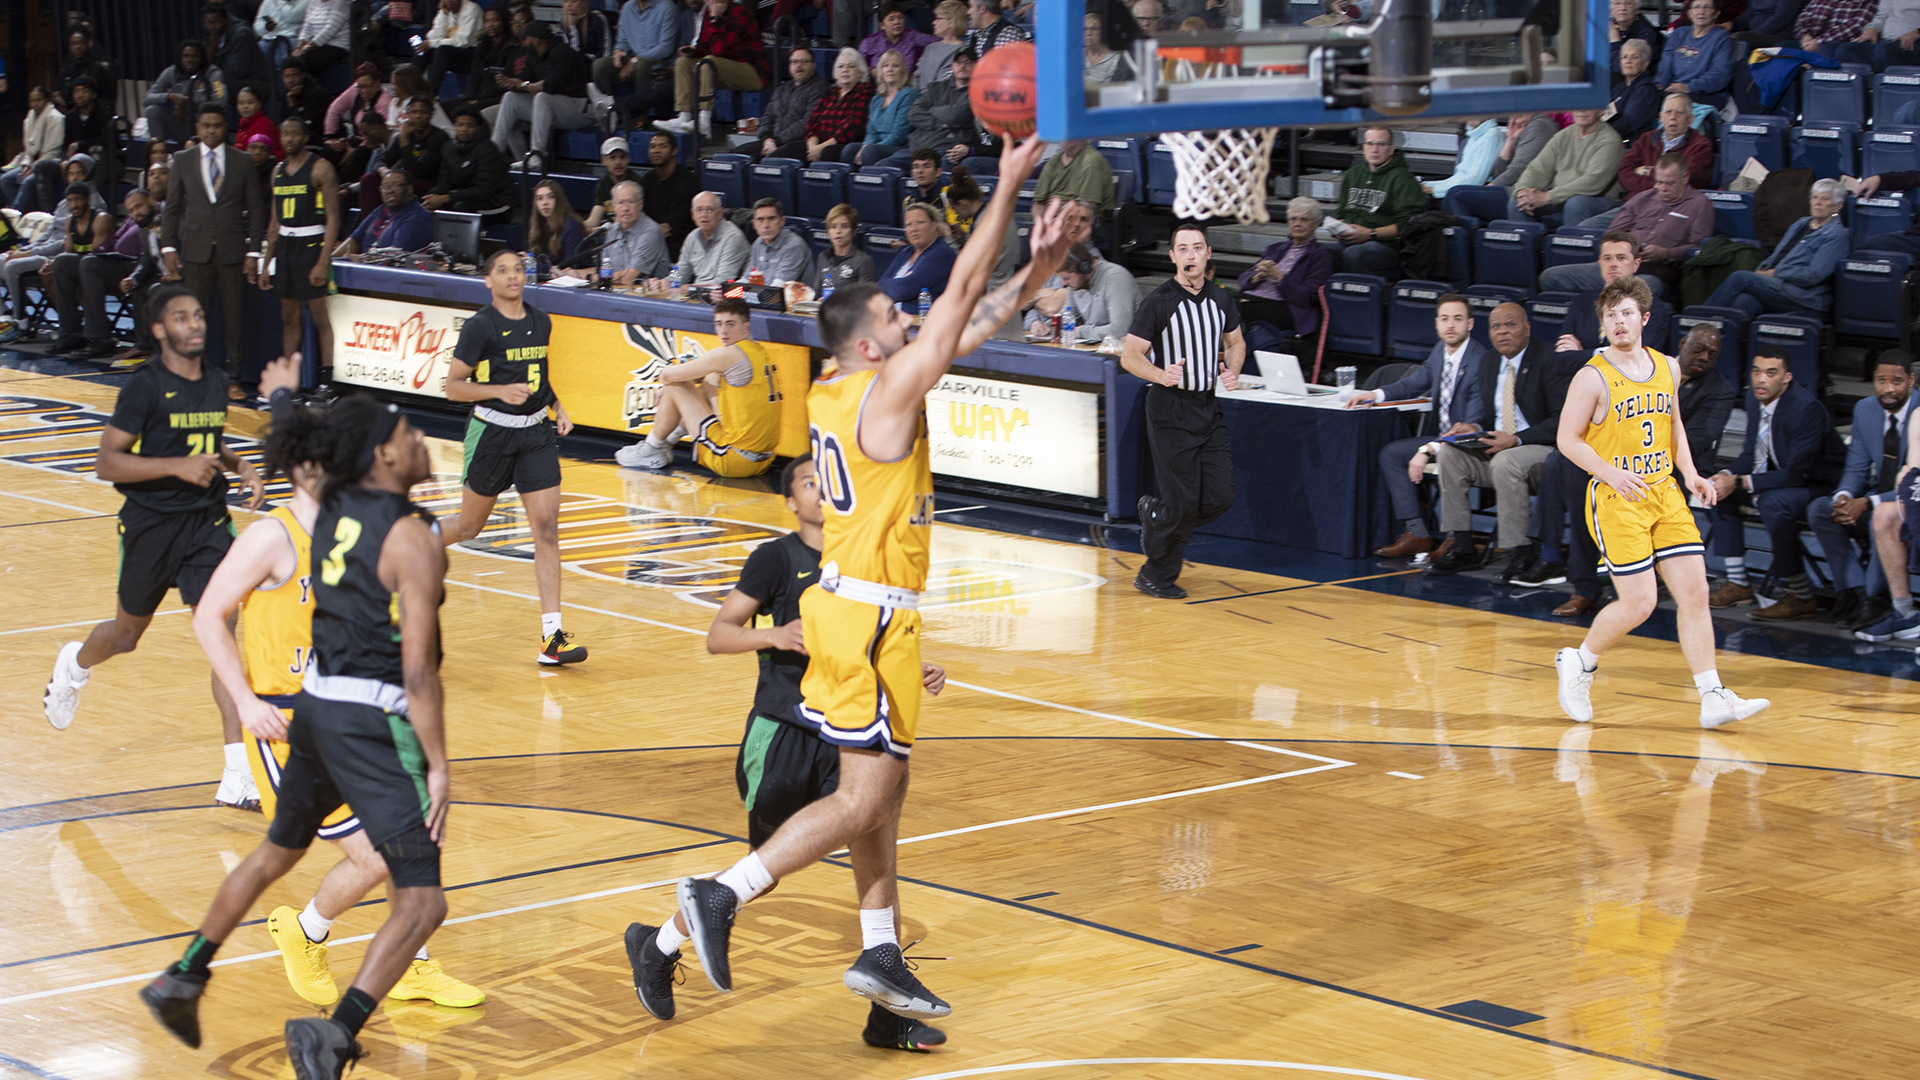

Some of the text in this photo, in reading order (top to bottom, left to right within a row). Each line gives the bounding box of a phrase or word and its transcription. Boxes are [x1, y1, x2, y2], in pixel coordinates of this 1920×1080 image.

[344, 320, 400, 352] SCREEN
[344, 362, 405, 386] 374-2646
[527, 363, 541, 392] 5
[187, 433, 215, 457] 21
[1641, 420, 1655, 448] 3
[321, 516, 362, 587] 3
